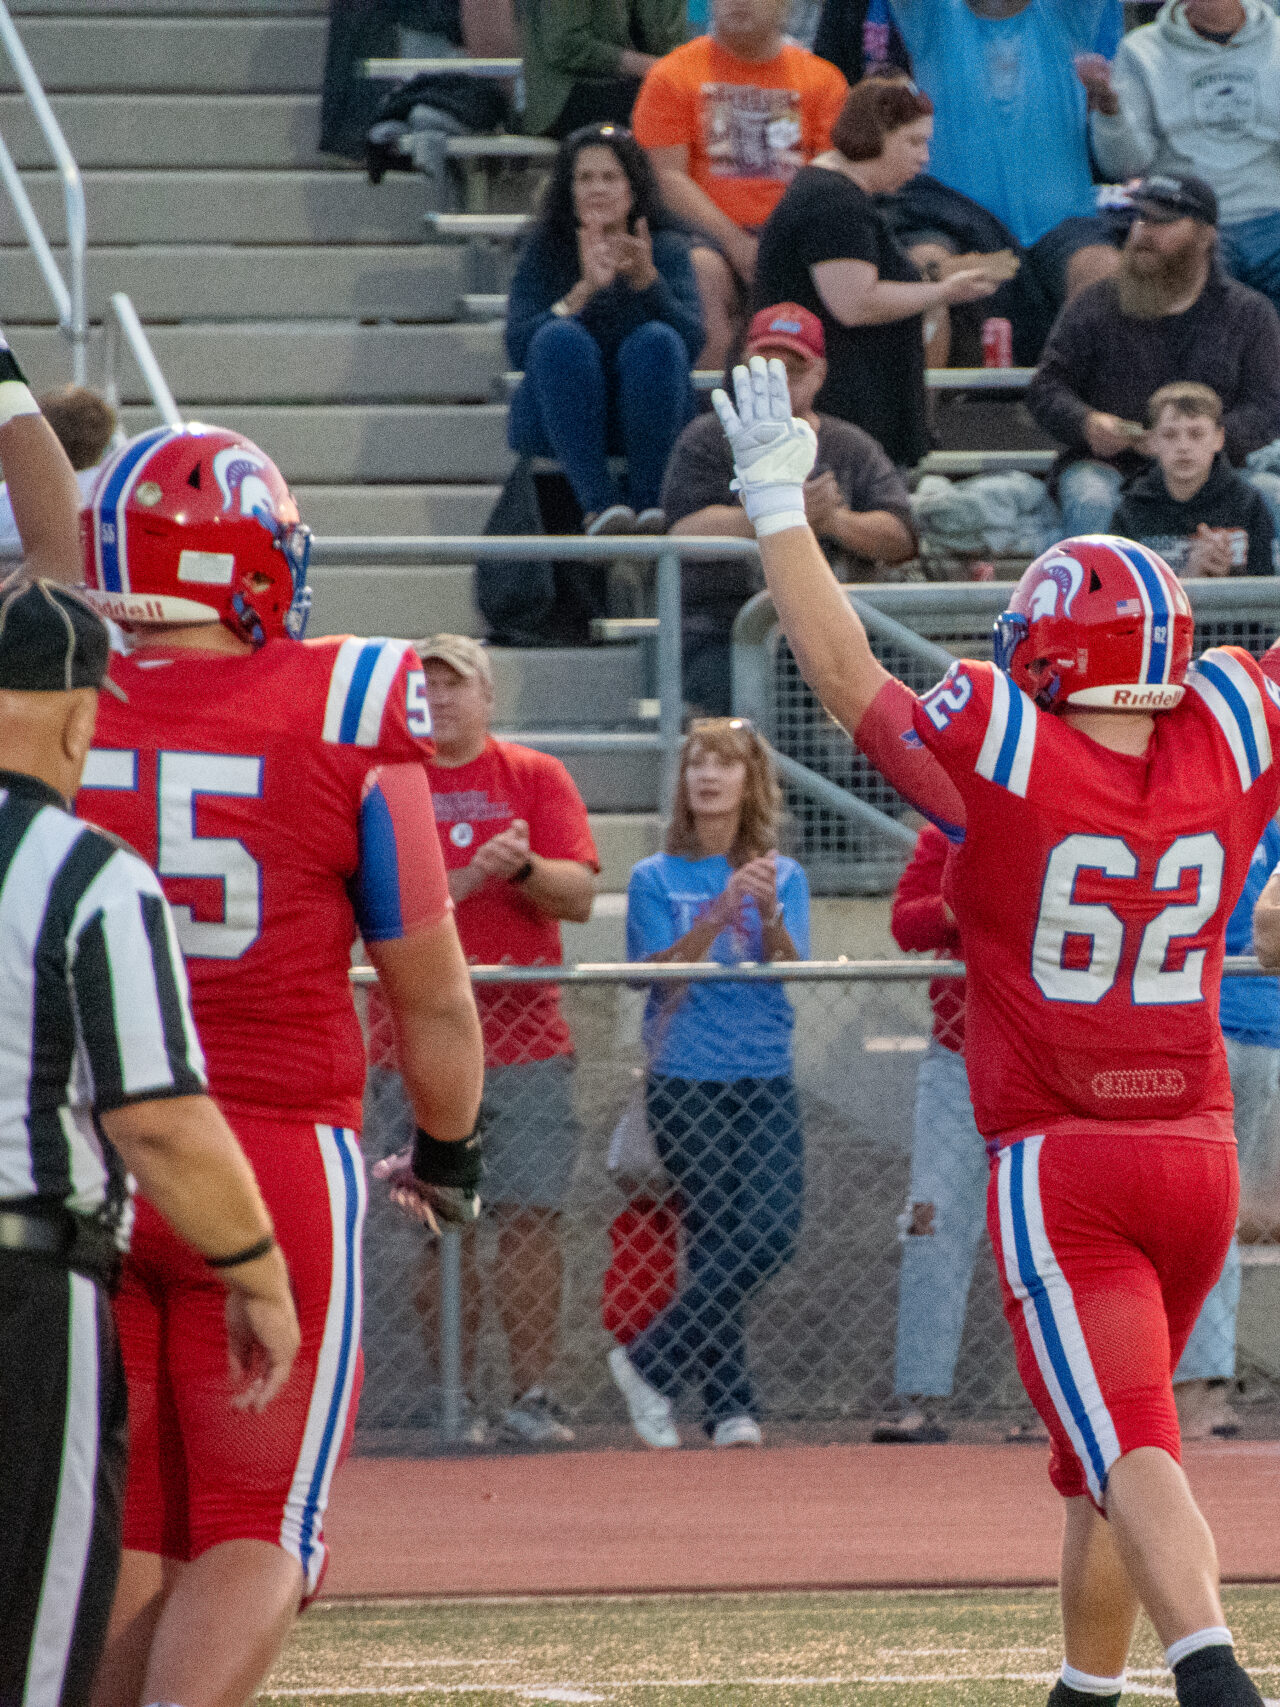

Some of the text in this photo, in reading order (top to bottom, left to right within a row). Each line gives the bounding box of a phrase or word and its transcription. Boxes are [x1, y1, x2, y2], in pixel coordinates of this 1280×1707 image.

[1154, 625, 1167, 643] 62
[1113, 689, 1182, 706] Riddell
[78, 748, 265, 960] 5
[1032, 831, 1226, 1006] 62
